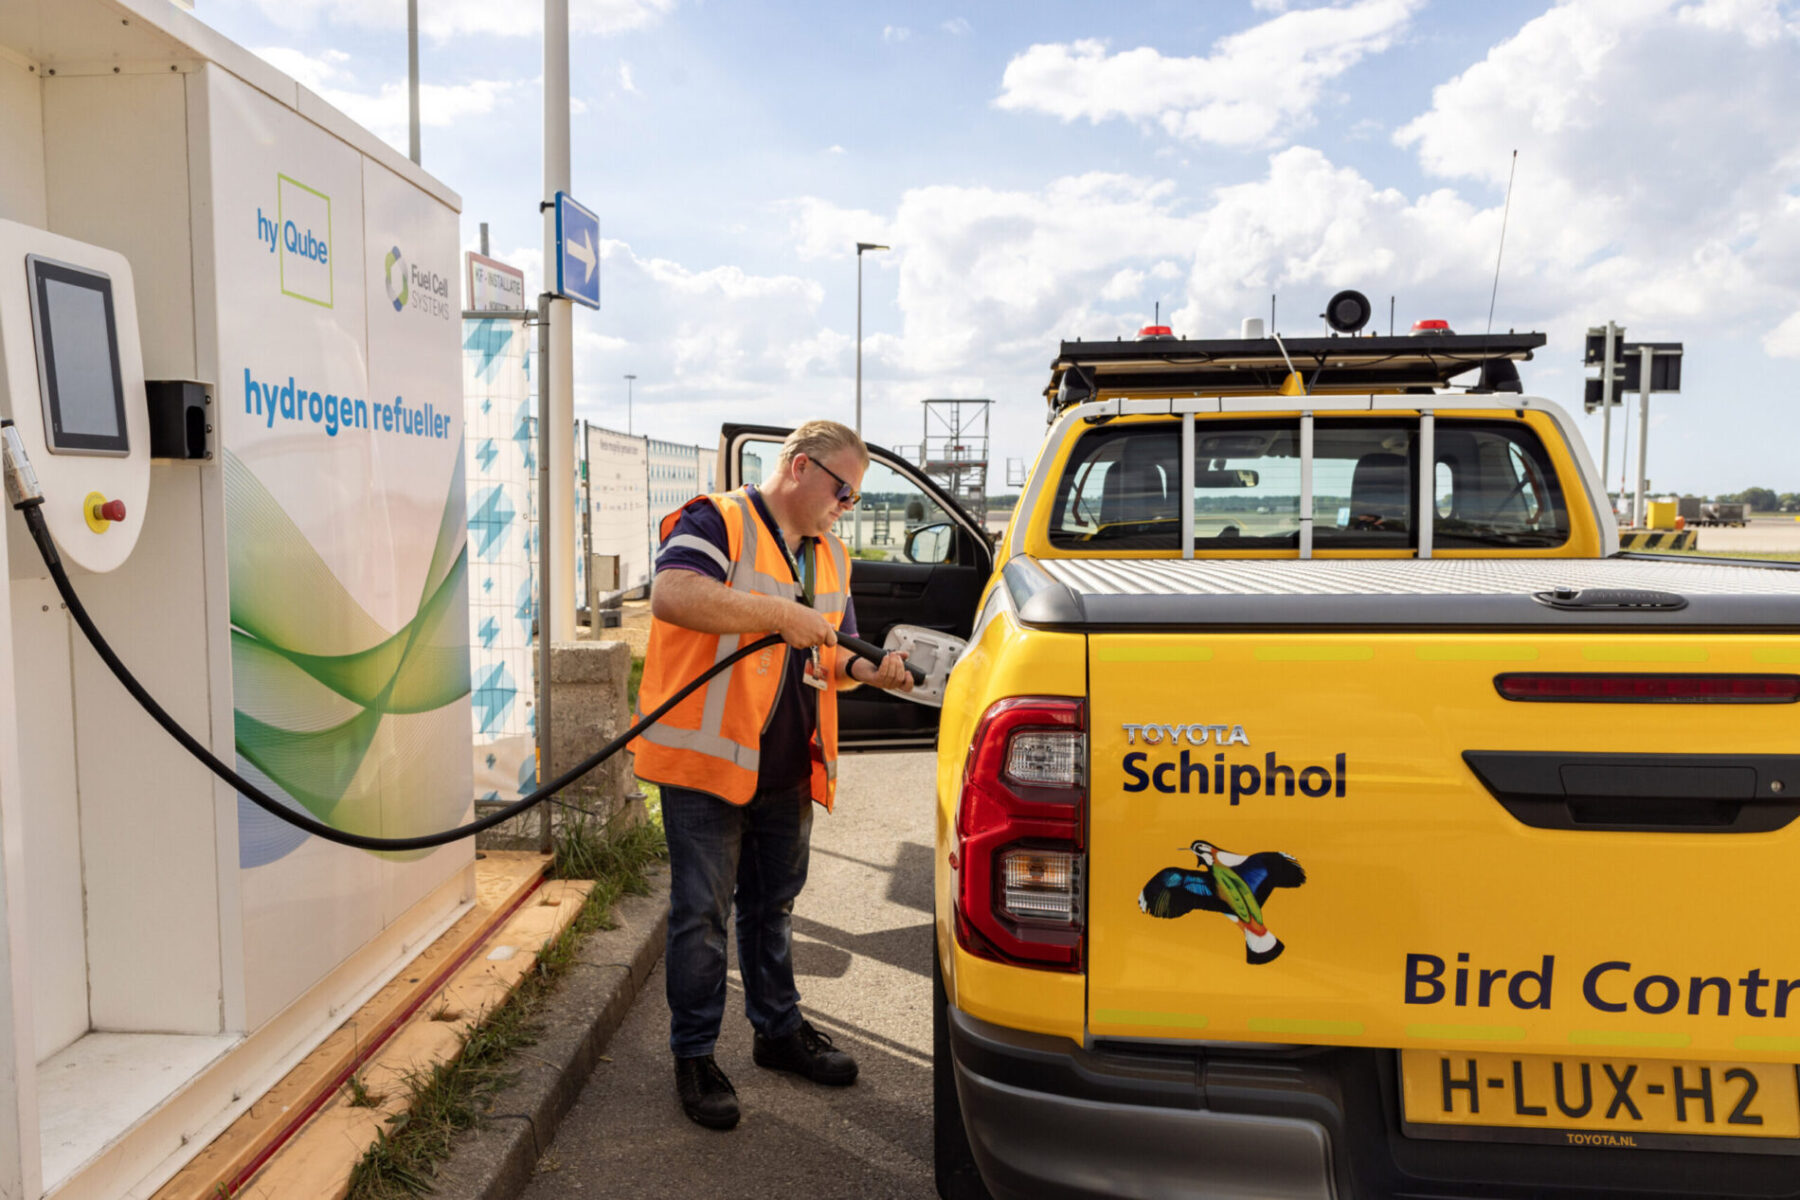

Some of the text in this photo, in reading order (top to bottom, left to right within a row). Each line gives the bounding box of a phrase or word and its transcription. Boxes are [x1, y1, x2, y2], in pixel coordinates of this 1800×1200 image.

[257, 207, 328, 264] hy Qube
[411, 263, 449, 299] Fuel Cell
[411, 289, 449, 321] SYSTEMS
[244, 367, 451, 439] hydrogen refueller
[1122, 723, 1250, 746] TOYOTA
[1122, 749, 1347, 806] Schiphol
[1404, 952, 1800, 1018] Bird Contr
[1441, 1058, 1763, 1126] H-LUX-H2
[1566, 1133, 1638, 1147] TOYOTA.NL
